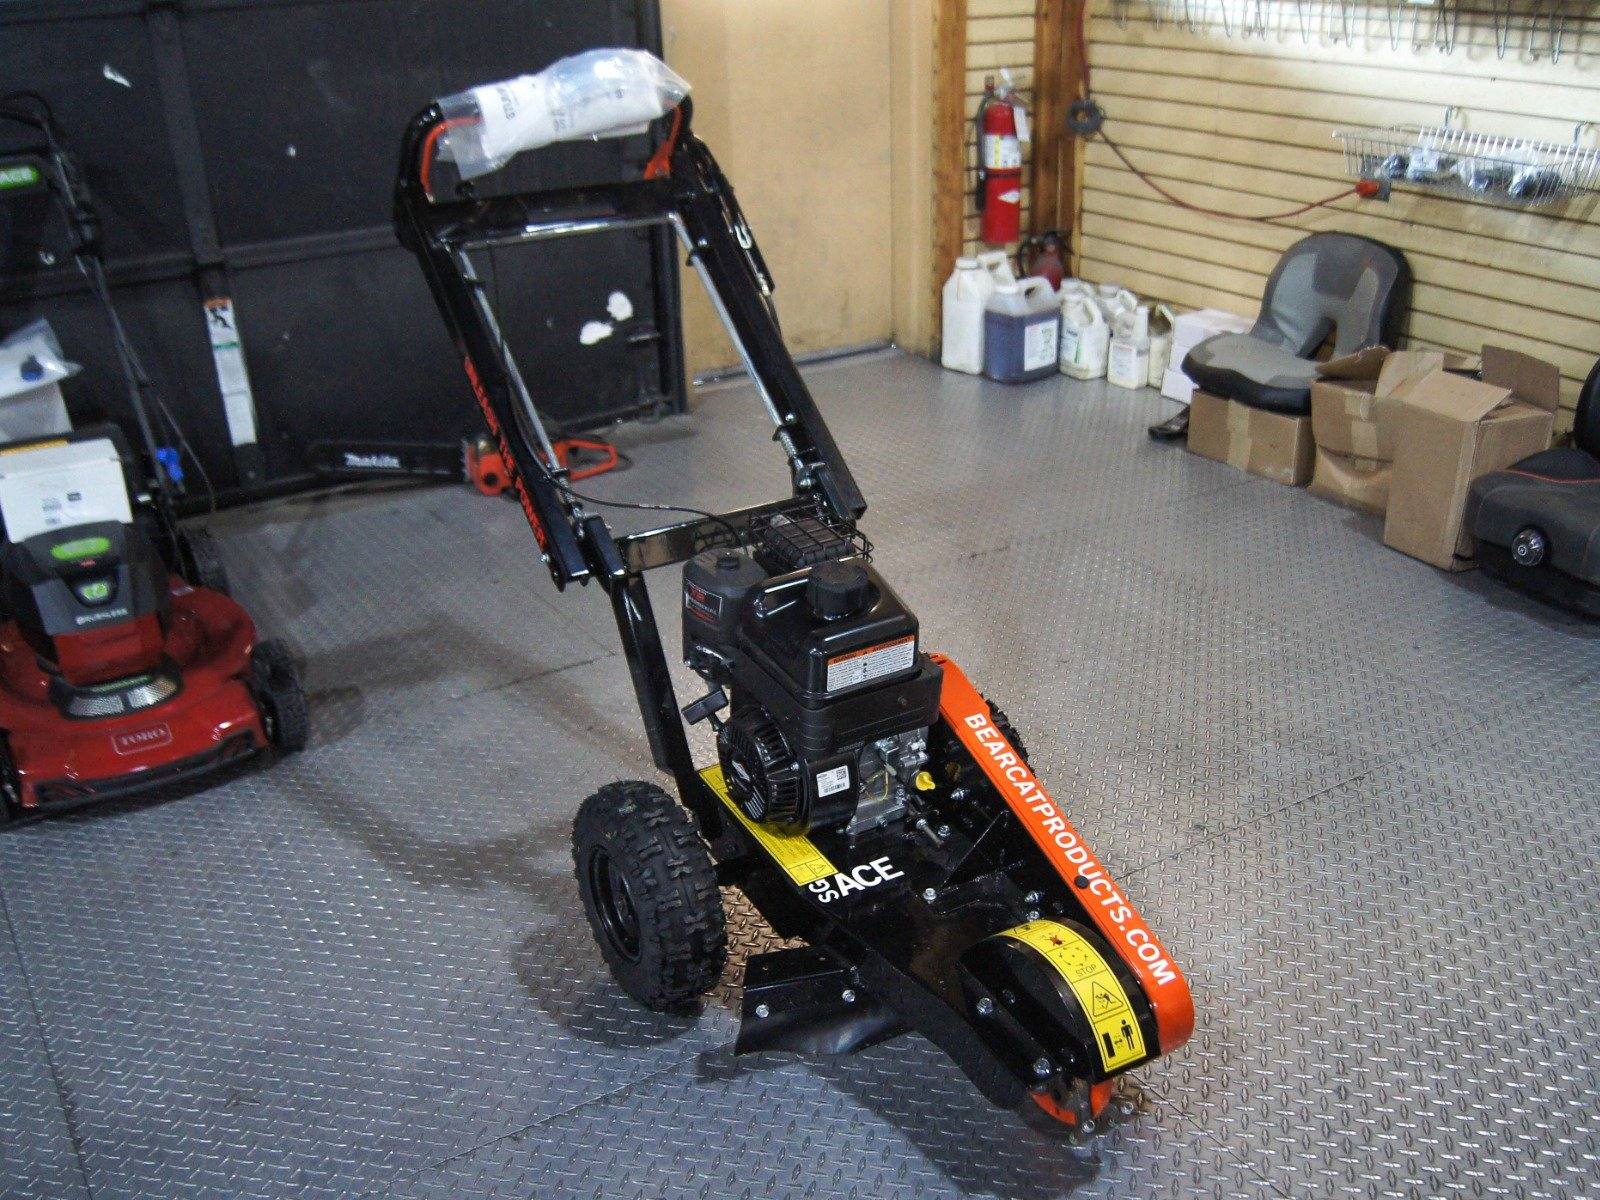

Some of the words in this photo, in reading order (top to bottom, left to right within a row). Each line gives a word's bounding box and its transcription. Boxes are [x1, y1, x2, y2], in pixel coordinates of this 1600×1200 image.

[964, 713, 1176, 985] BEARCATPRODUCTS.COM
[808, 879, 840, 903] SG
[834, 856, 905, 897] ACE
[1075, 963, 1097, 977] STOP
